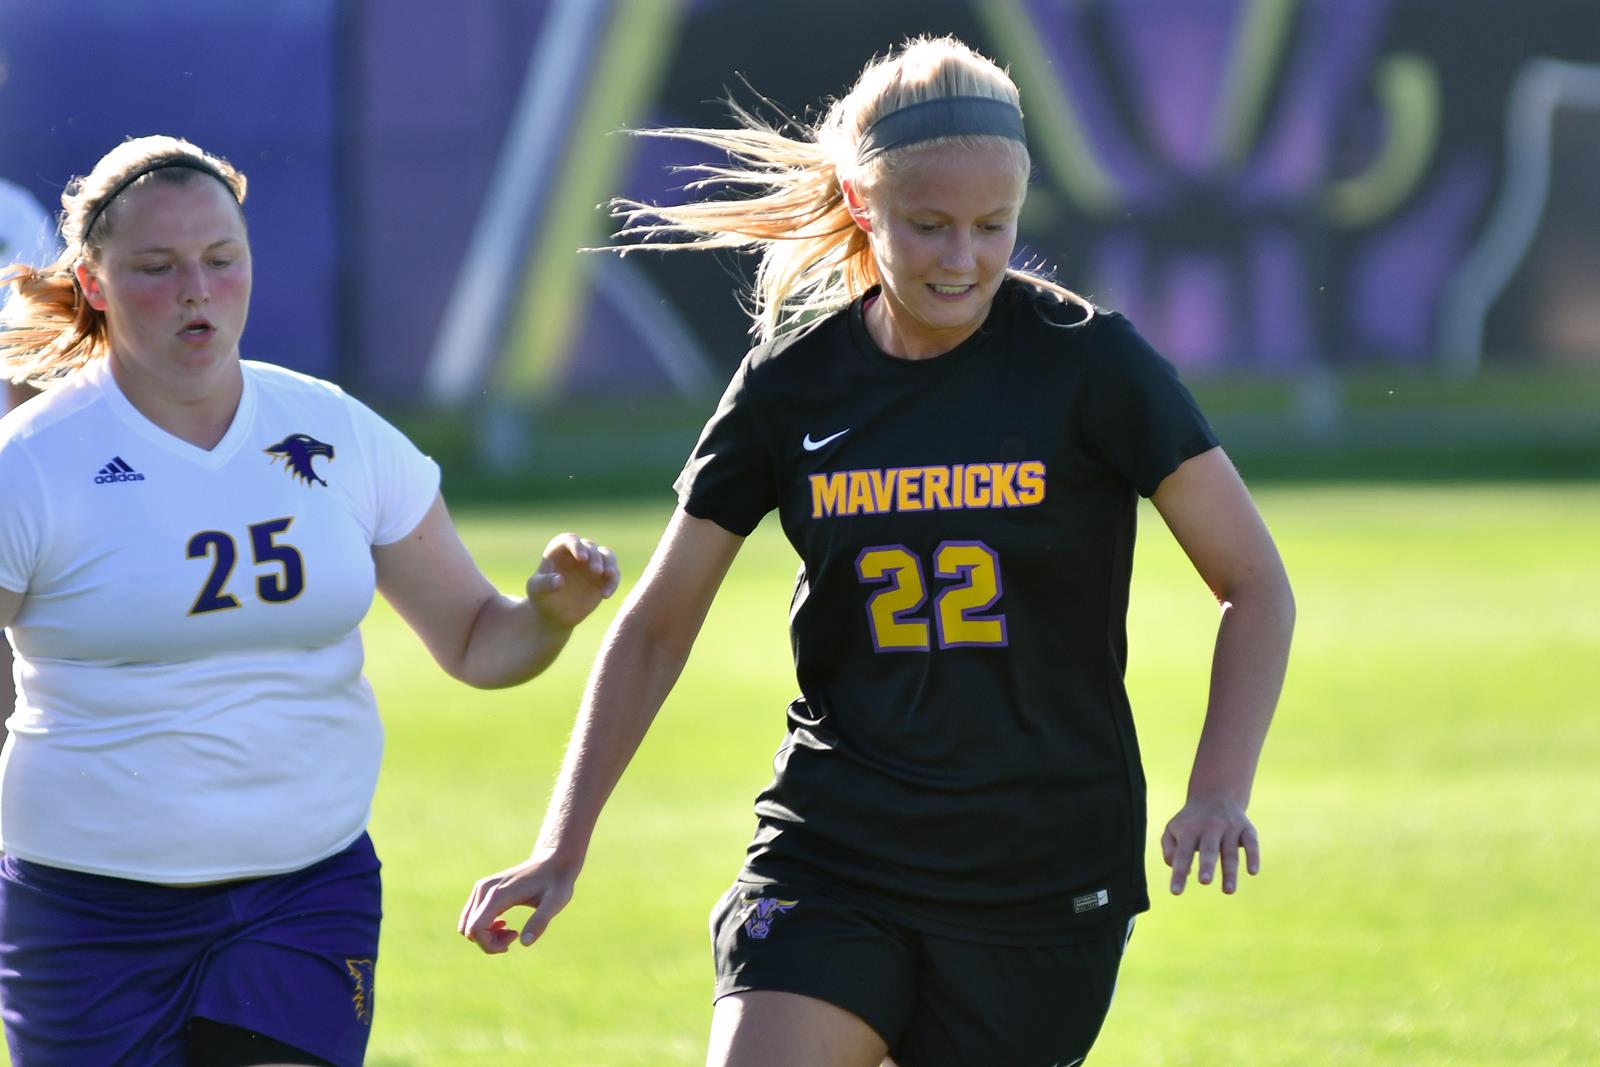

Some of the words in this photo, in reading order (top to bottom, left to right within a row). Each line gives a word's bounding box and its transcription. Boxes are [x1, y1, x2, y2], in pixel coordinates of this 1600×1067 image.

[94, 472, 145, 485] adidas
[808, 460, 1046, 519] MAVERICKS
[185, 515, 305, 617] 25
[854, 540, 1009, 653] 22
